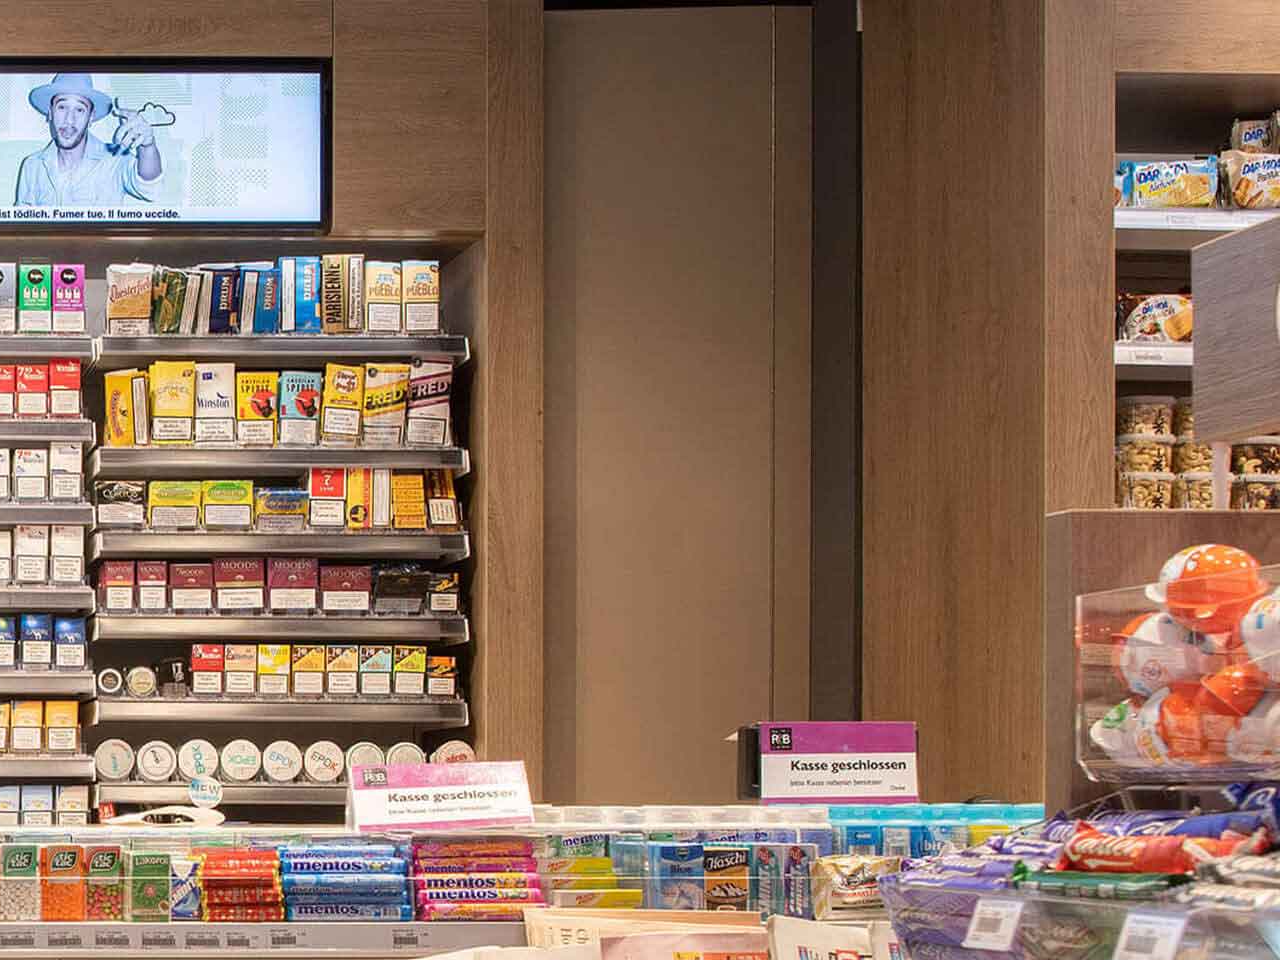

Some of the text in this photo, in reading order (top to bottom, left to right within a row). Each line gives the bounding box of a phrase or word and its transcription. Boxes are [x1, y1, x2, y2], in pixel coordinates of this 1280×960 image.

[13, 209, 50, 219] tödlich.
[52, 209, 85, 219] Fumer
[87, 209, 106, 219] tue.
[116, 209, 142, 219] fumo
[144, 209, 180, 219] uccide.
[325, 263, 341, 324] PARISIENNE
[410, 380, 449, 398] FRED
[197, 397, 229, 409] Winston
[365, 387, 404, 408] FRED
[221, 561, 258, 569] MOODS
[274, 561, 311, 569] MOODS
[790, 759, 907, 773] Kasse geschlossen
[388, 789, 518, 804] Kasse geschlossen
[293, 859, 363, 872] mentos
[426, 876, 497, 889] mentos
[297, 903, 361, 915] mentos
